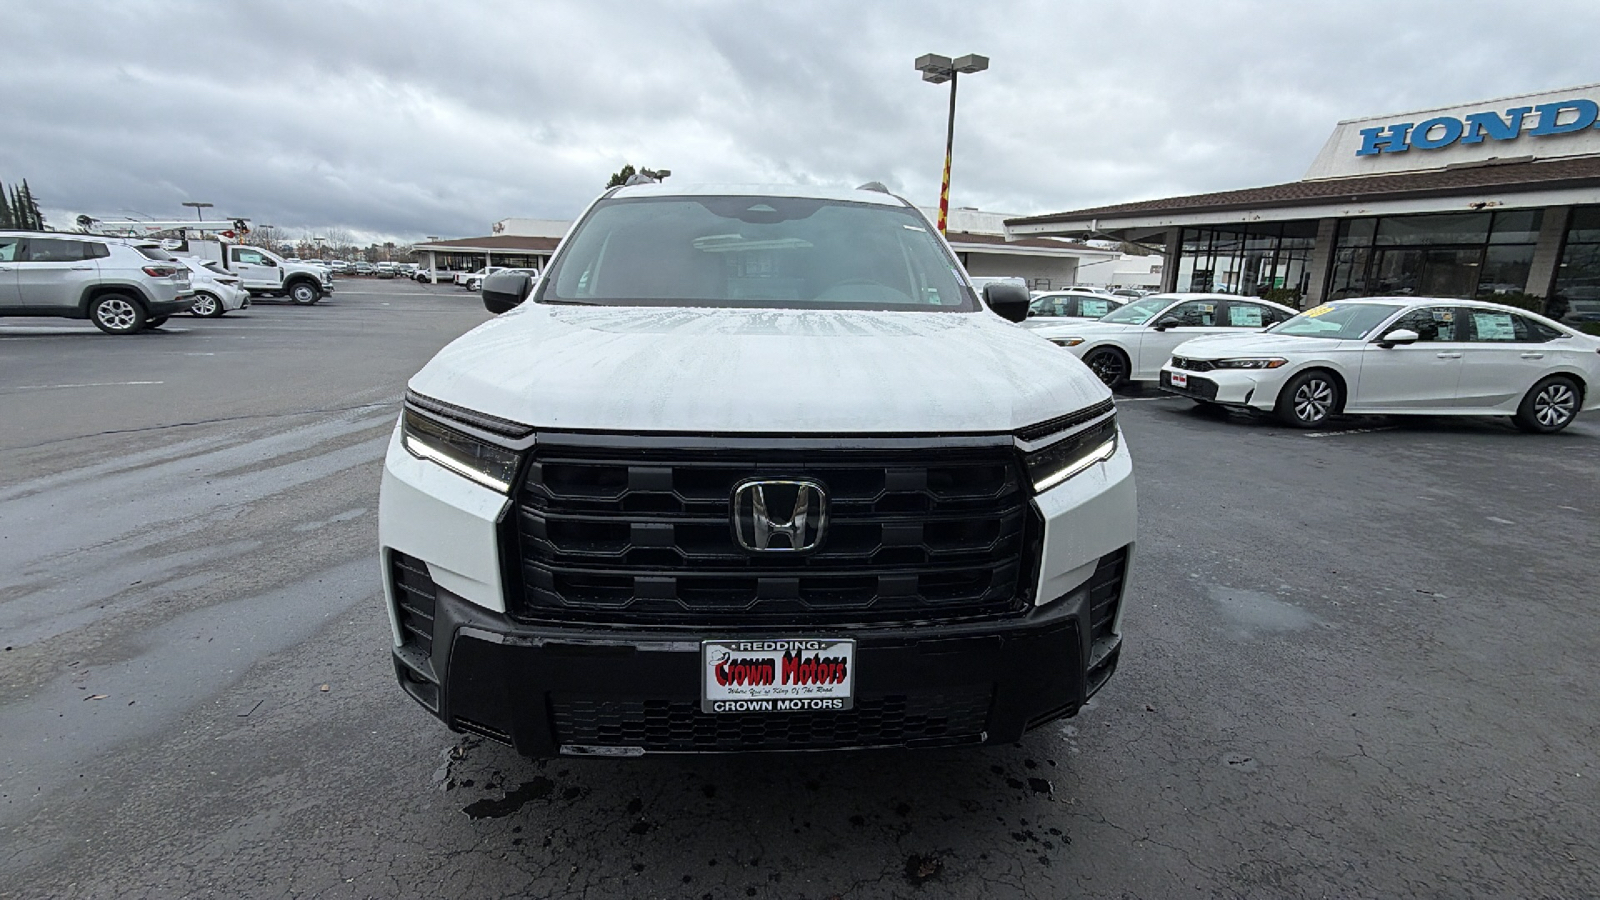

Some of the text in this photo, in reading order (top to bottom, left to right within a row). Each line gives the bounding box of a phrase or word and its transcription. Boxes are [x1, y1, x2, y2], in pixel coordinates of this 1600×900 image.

[1356, 99, 1600, 157] HOND
[740, 641, 819, 651] REDDING
[714, 649, 848, 687] Crown Motors
[791, 687, 800, 695] Of
[801, 686, 814, 694] The
[714, 699, 843, 712] CROWN MOTORS
